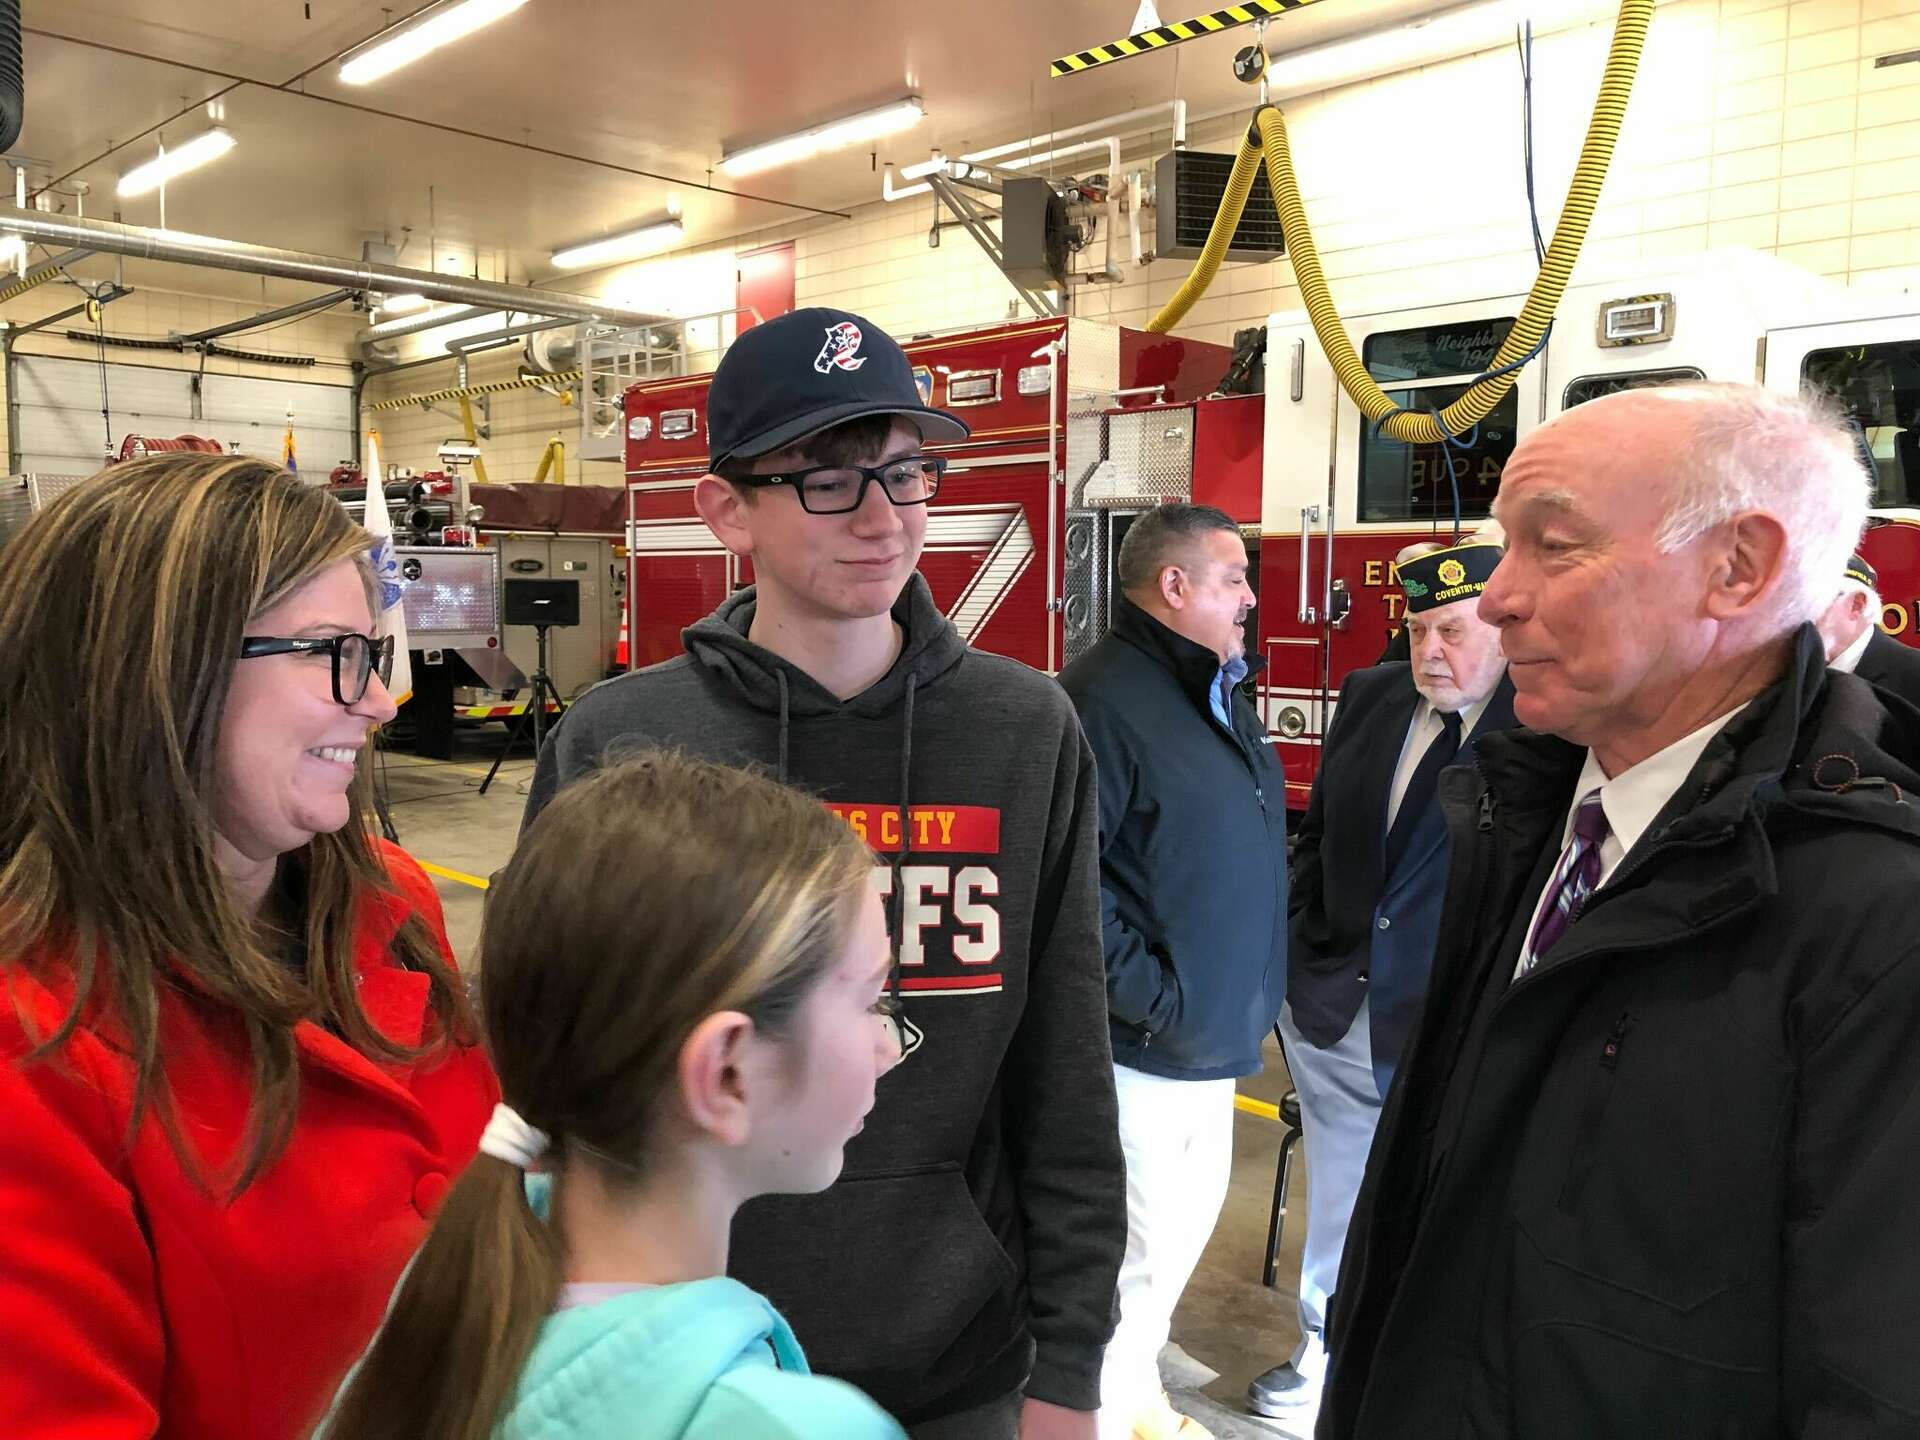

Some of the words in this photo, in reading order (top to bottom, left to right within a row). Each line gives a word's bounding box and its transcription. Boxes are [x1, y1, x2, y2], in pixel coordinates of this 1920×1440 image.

[1435, 329, 1503, 351] Neighbo
[832, 809, 868, 841] S
[880, 811, 956, 845] CTY
[871, 865, 1001, 967] FS
